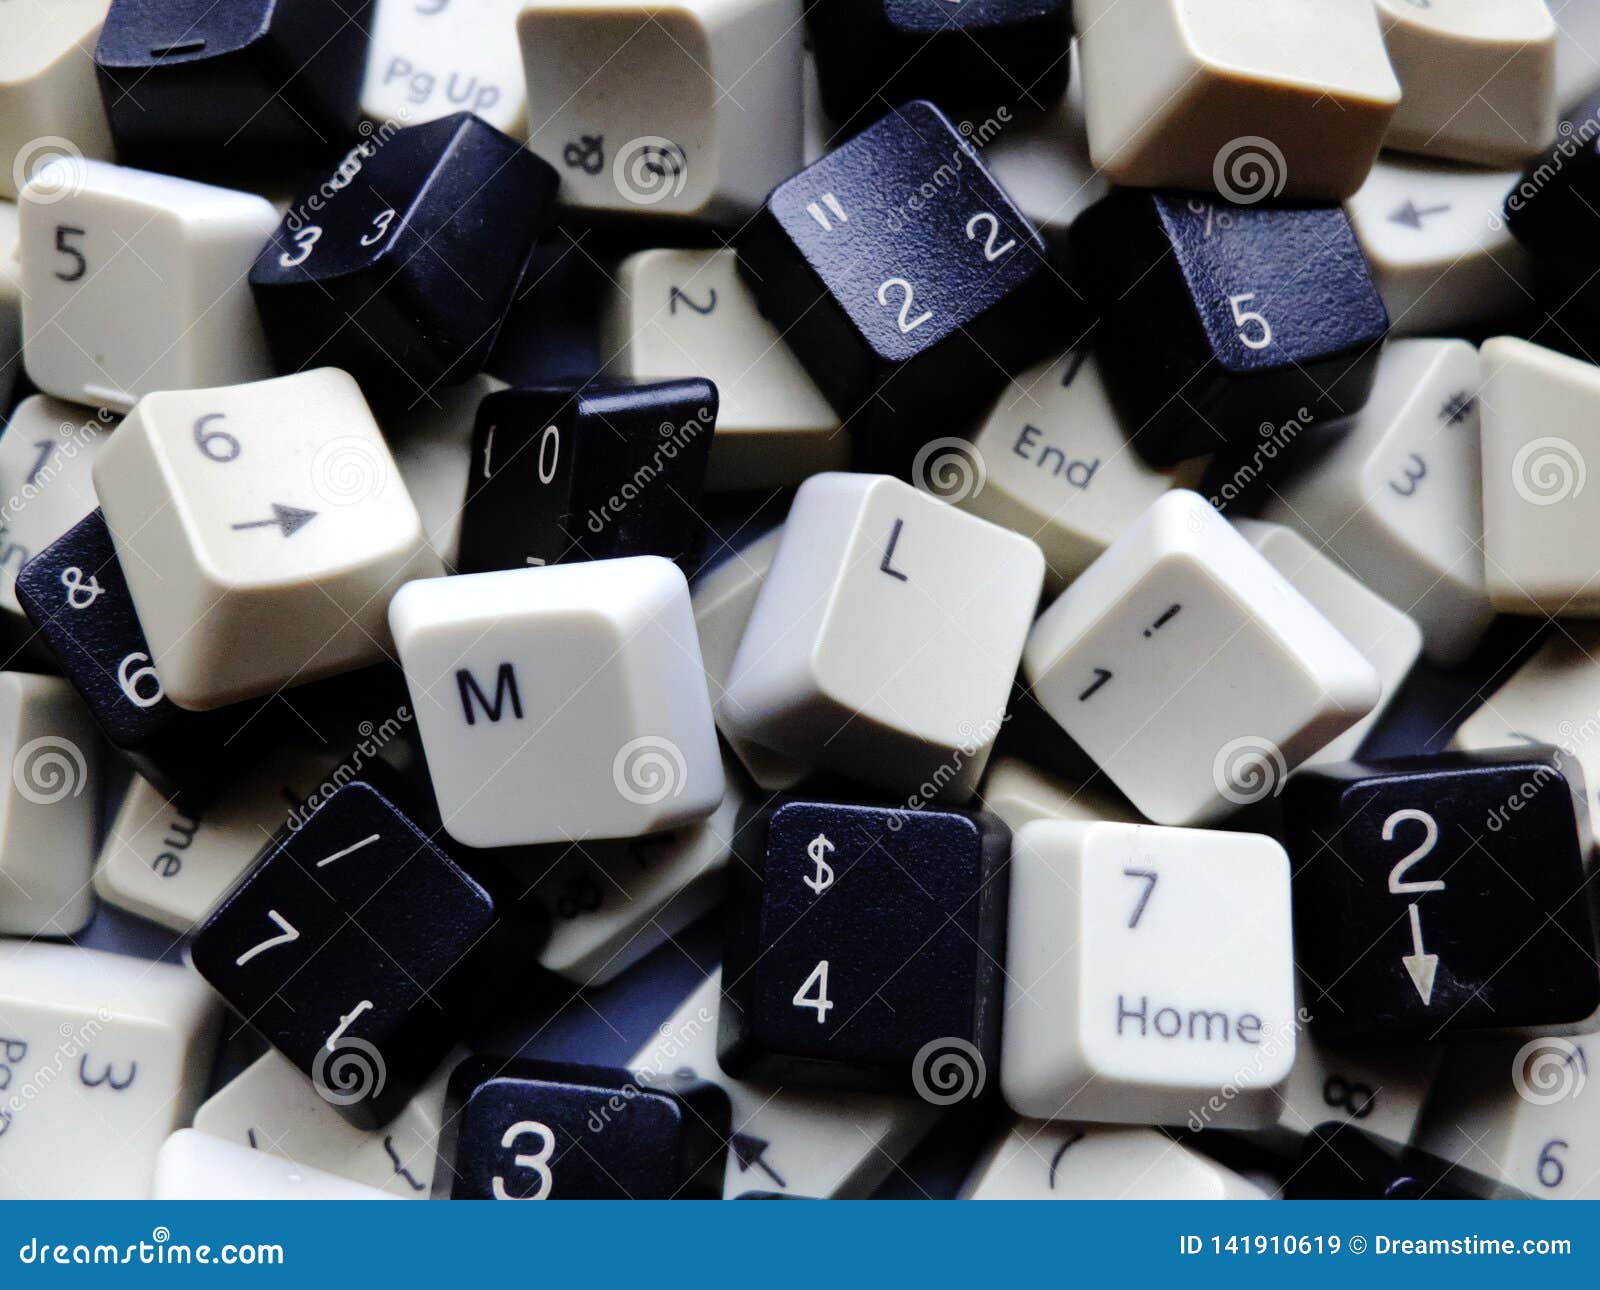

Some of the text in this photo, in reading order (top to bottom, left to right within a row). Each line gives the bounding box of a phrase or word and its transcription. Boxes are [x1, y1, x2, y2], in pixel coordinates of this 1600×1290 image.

[383, 57, 501, 112] Pg Up
[54, 227, 87, 283] 5
[279, 224, 323, 268] 3
[360, 208, 396, 247] 3
[965, 211, 1016, 262] 2
[876, 276, 933, 335] 2
[1228, 292, 1272, 350] 5
[193, 412, 242, 464] 6
[1013, 424, 1101, 490] End
[879, 517, 909, 583] L
[61, 566, 105, 610] &
[117, 651, 164, 709] 6
[455, 662, 524, 726] M
[1079, 667, 1114, 702] 1
[803, 833, 836, 895] $
[1381, 808, 1446, 894] 2
[1122, 867, 1159, 930] 7
[235, 909, 301, 967] 7
[792, 960, 834, 1024] 4
[1115, 994, 1263, 1045] Home
[79, 1052, 137, 1091] 3
[491, 1120, 557, 1200] 3
[1537, 1138, 1569, 1188] 6
